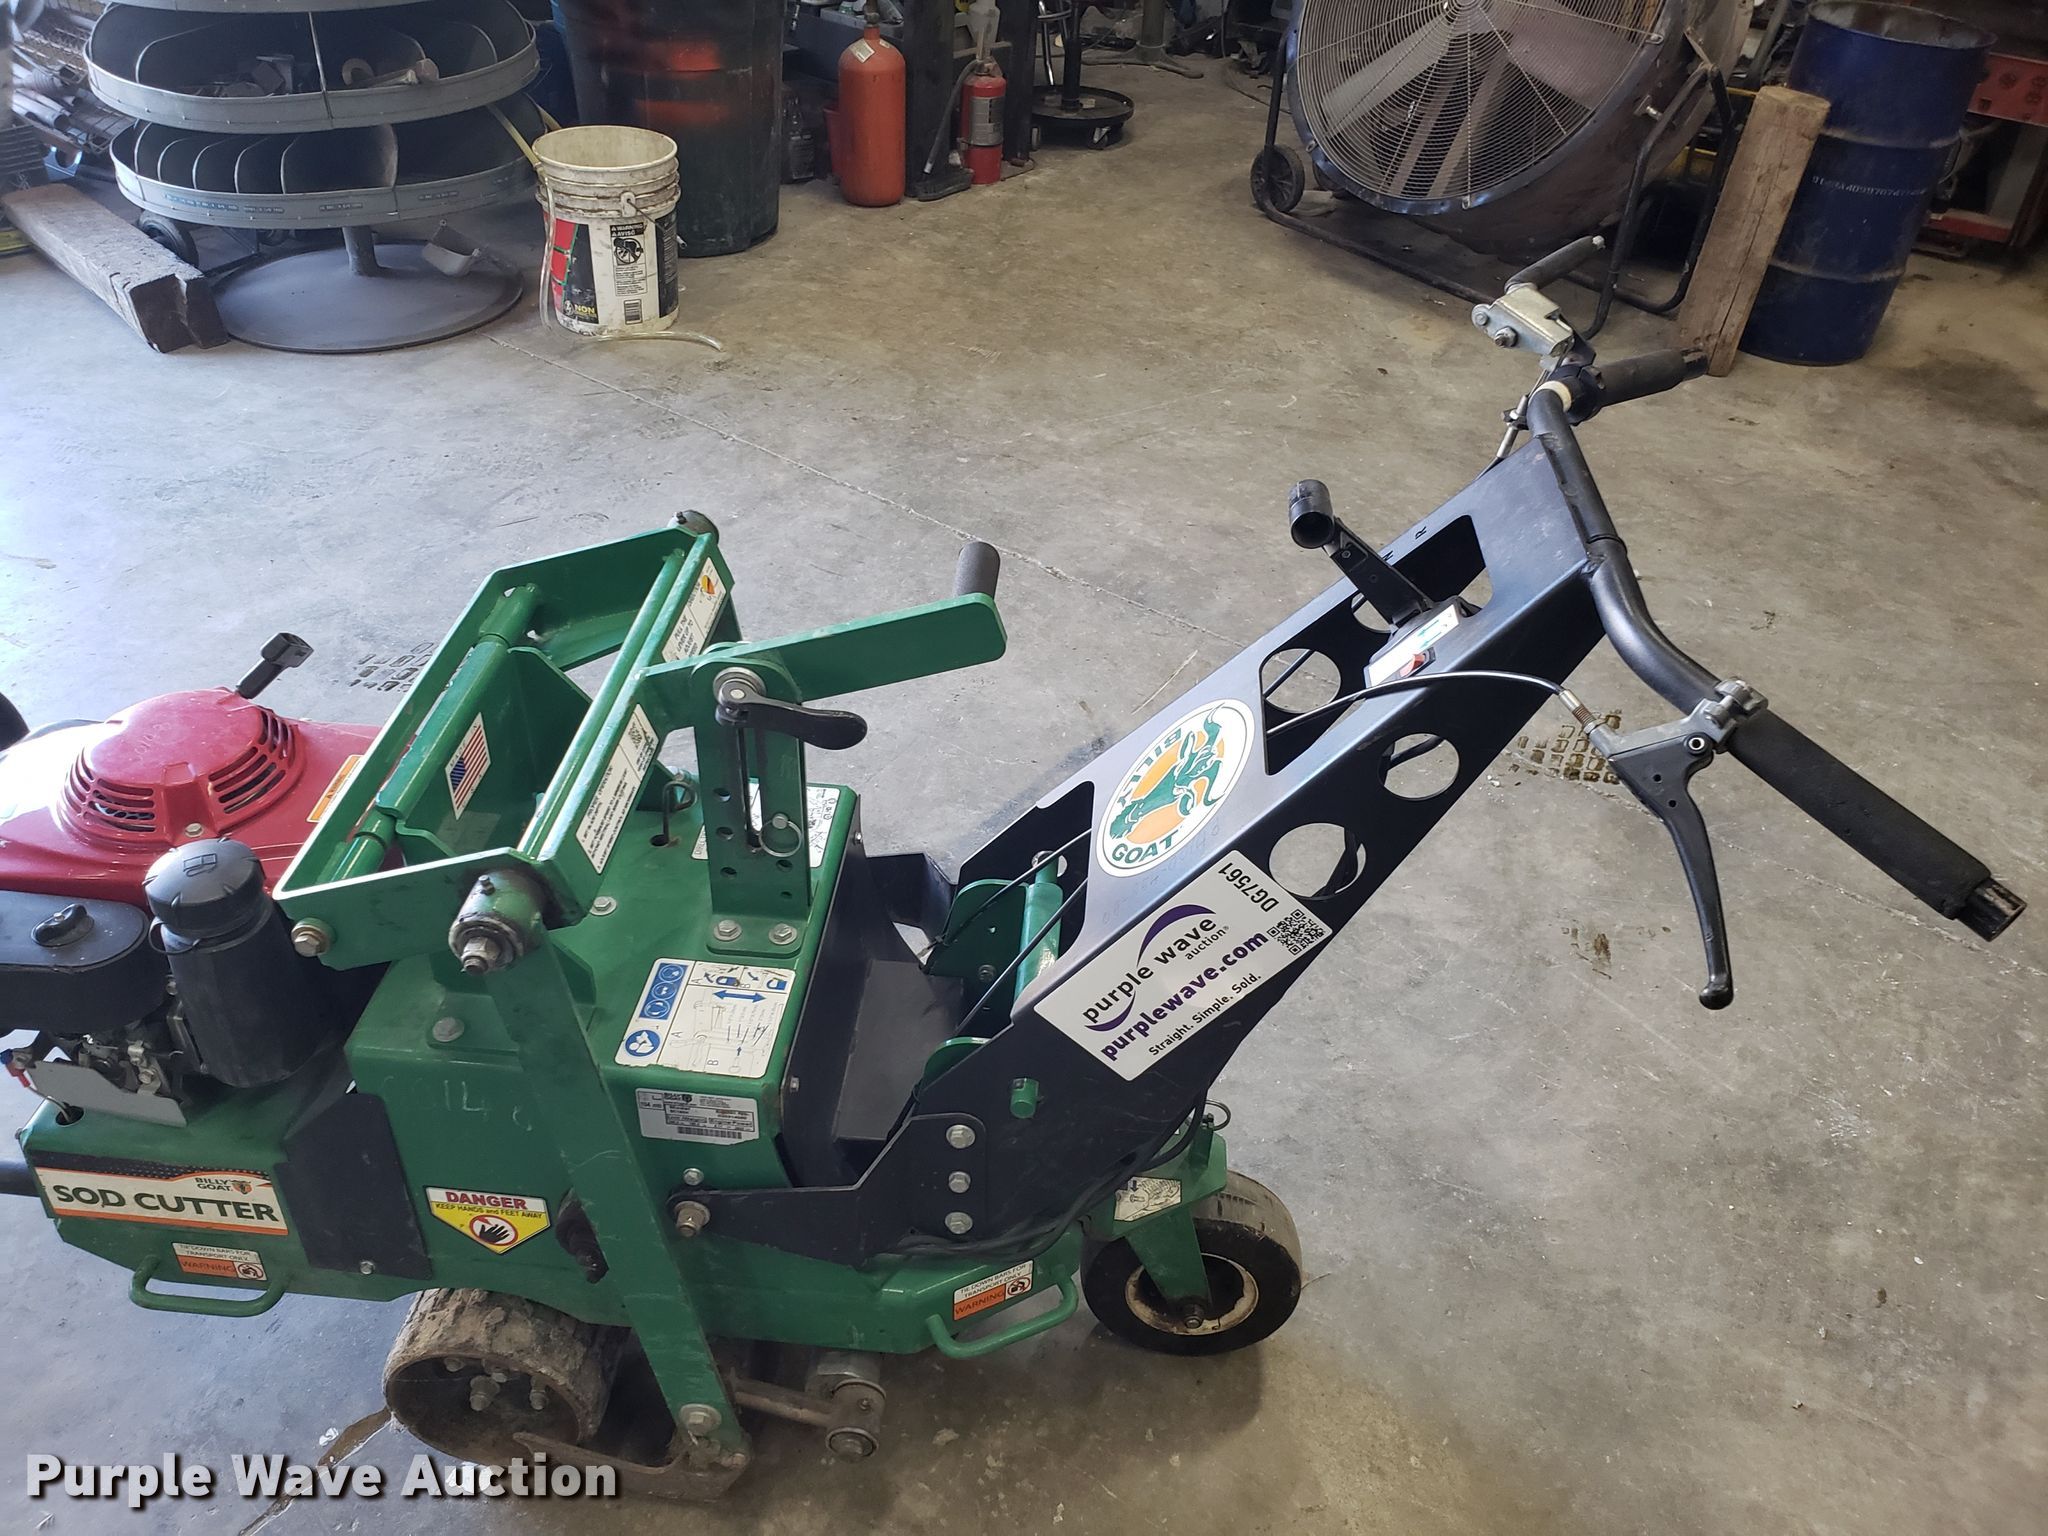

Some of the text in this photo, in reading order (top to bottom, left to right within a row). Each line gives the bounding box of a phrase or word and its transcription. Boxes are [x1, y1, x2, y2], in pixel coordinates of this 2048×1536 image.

[1415, 526, 1427, 540] R
[1116, 728, 1182, 807] BILLY
[1112, 829, 1179, 864] GOAT
[1218, 862, 1280, 913] DG7561
[1082, 918, 1217, 1024] purple wave
[1101, 932, 1269, 1061] purplewave.com
[1148, 973, 1262, 1056] Straight. Simple. Sold.
[195, 1177, 229, 1185] BILLY
[197, 1183, 231, 1191] GOAT
[53, 1184, 279, 1222] SOD CUTTER
[435, 1203, 456, 1211] KEEP
[458, 1205, 485, 1213] HANDS
[500, 1209, 520, 1217] FEET
[521, 1211, 542, 1219] AWAY
[445, 1191, 528, 1210] DANGER
[182, 1261, 236, 1272] WARNING
[994, 1270, 1011, 1281] BARS
[1012, 1264, 1026, 1273] FOR
[964, 1272, 1021, 1298] TRANSPORT ONLY
[955, 1290, 1004, 1314] WARNING
